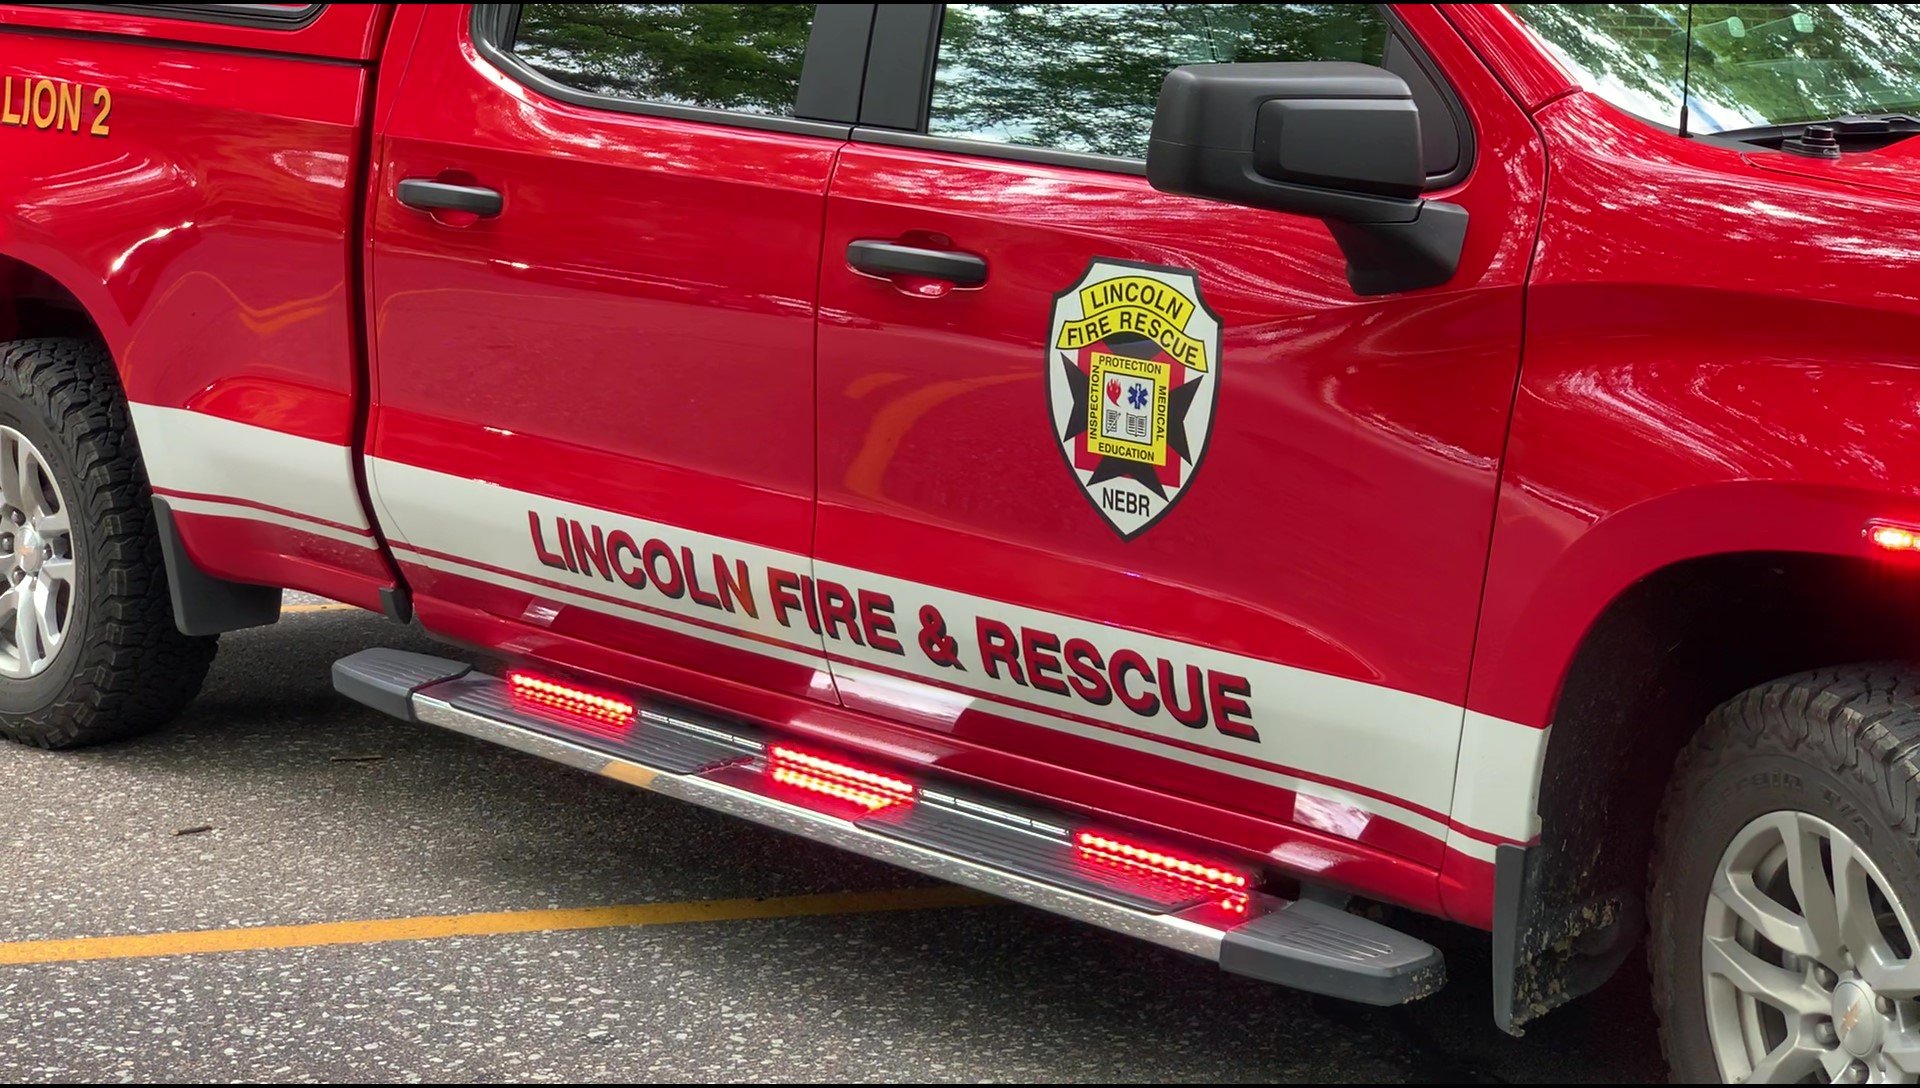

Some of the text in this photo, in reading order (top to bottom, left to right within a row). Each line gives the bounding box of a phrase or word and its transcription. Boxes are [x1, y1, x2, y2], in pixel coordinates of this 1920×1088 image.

[2, 76, 112, 136] LION 2
[1091, 282, 1183, 320] LINCOLN
[1067, 311, 1199, 366] FIRE RESCUE
[1099, 355, 1162, 375] PROTECTION
[1089, 365, 1100, 440] INSPECTION
[1156, 385, 1167, 442] MEDICAL
[1098, 442, 1155, 462] EDUCATION
[1102, 487, 1150, 518] NEBR
[528, 510, 1261, 744] LINCOLN FIRE & RESCUE
